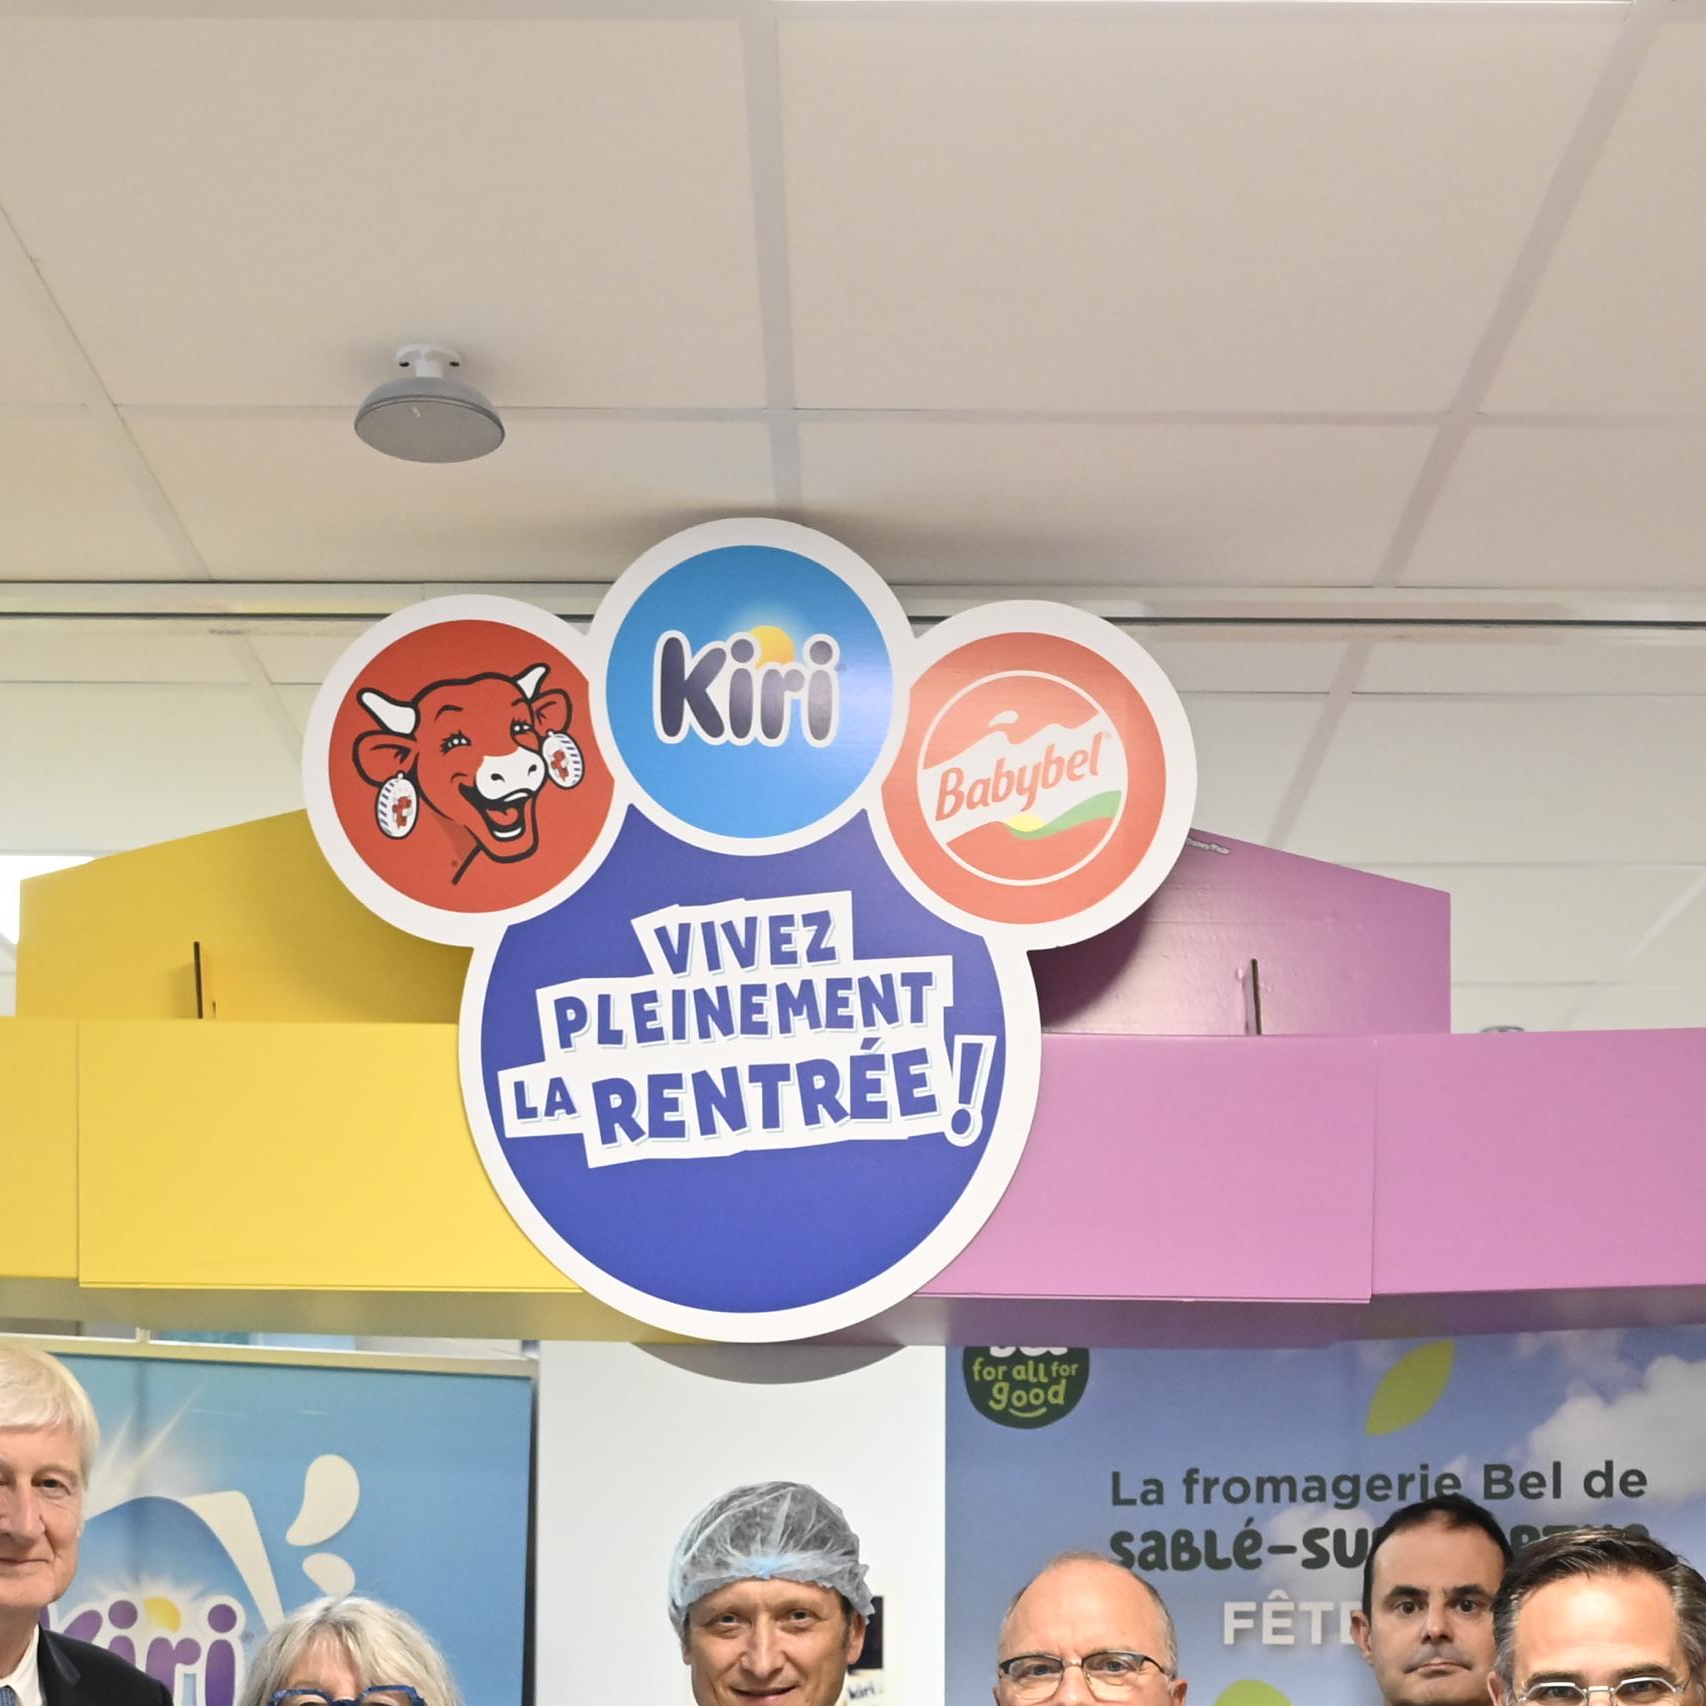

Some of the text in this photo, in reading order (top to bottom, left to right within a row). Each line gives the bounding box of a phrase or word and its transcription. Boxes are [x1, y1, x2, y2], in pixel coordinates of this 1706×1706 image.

[653, 630, 840, 747] Kiri
[935, 731, 1103, 822] Babybel
[654, 910, 837, 975] VIVEZ
[553, 971, 933, 1050] PLEINEMENT
[513, 1077, 577, 1120] LA
[972, 1357, 1079, 1383] for all for
[989, 1379, 1067, 1410] good
[1111, 1459, 1648, 1511] La fromagerie Bel de
